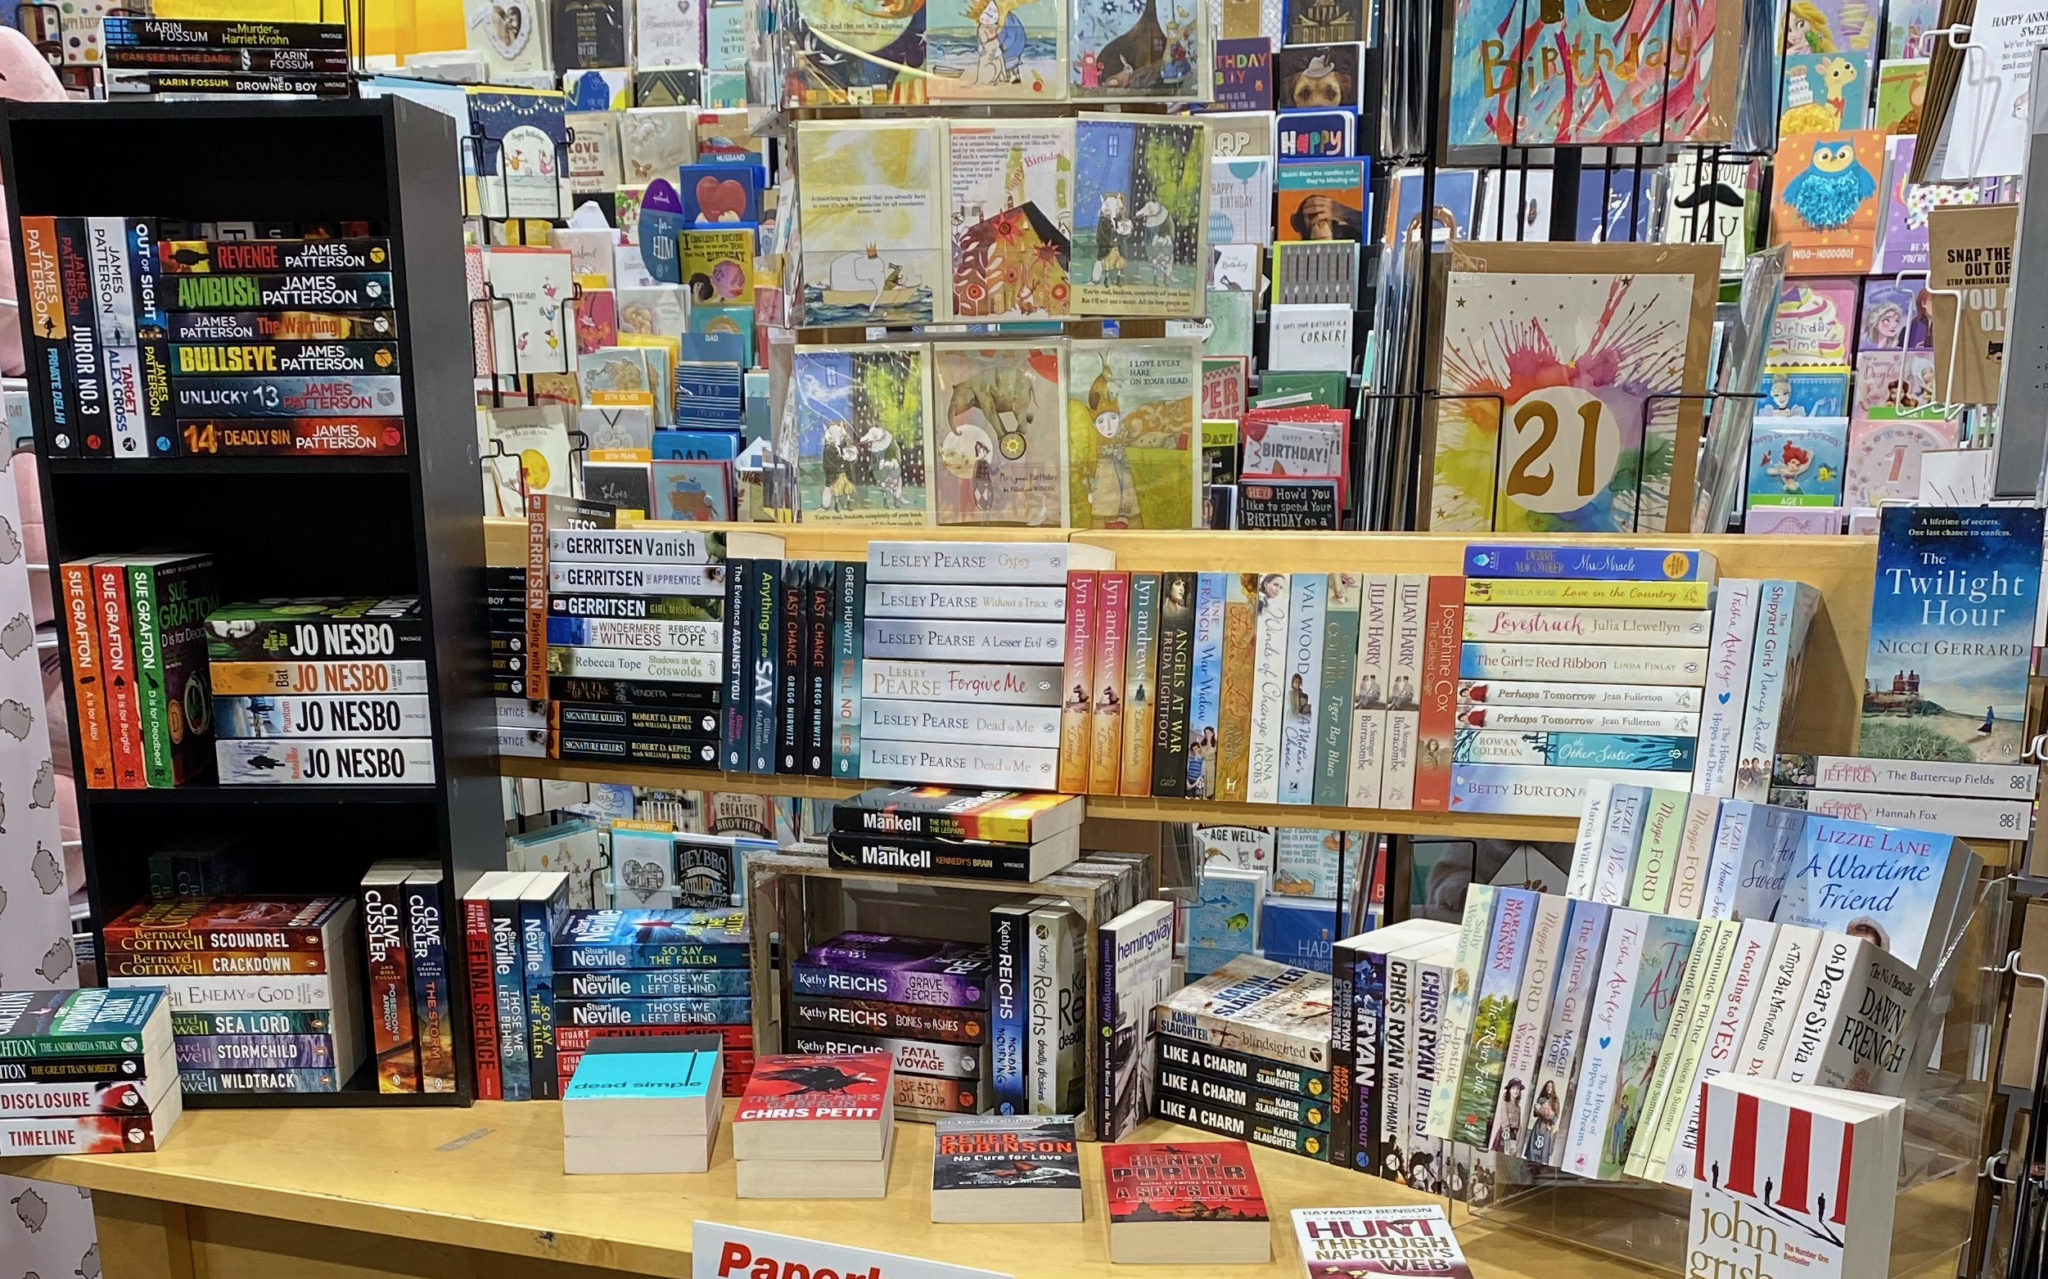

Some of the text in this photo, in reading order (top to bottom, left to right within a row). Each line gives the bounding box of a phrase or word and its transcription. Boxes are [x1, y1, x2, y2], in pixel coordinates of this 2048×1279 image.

[145, 22, 182, 34] KARIN
[160, 31, 208, 42] FOSSUM
[222, 33, 289, 45] Harriet Krohn
[236, 81, 317, 92] DROWNED BOY
[716, 154, 745, 162] HUSBAND
[1212, 183, 1233, 194] HAPPY
[1220, 196, 1253, 209] BIRTHDAY
[217, 246, 279, 269] REVENGE
[301, 244, 348, 256] JAMES
[1947, 246, 2011, 264] SNAP THE
[286, 255, 365, 267] PATTERSON
[136, 224, 156, 320] OUT OF SIGHT
[179, 277, 260, 307] AMBUSH
[194, 316, 237, 327] JAMES
[258, 317, 336, 335] The Warning
[1773, 320, 1833, 339] Birthday
[180, 326, 252, 337] PATTERSON
[1301, 330, 1346, 344] CORKER!
[298, 346, 345, 358] JAMES
[1786, 339, 1817, 350] Time
[179, 347, 276, 372] BULLSEYE
[281, 357, 363, 370] PATTERSON
[72, 326, 99, 414] JUROR NO.3
[180, 387, 279, 407] UNLUCKY 13
[225, 430, 290, 445] DEADLY SIN
[1262, 445, 1329, 463] BIRTHDAY!
[1506, 400, 1602, 497] 21
[1246, 500, 1264, 510] like
[1267, 502, 1277, 511] to
[1281, 501, 1308, 512] spend
[1780, 496, 1797, 506] AGE
[1321, 517, 1327, 525] a
[567, 538, 695, 557] GERRITSEN Vanish
[530, 523, 544, 610] GERRITSEN
[1920, 552, 1946, 565] The
[568, 569, 701, 586] GERRITSEN APPRENTICE
[1885, 568, 2024, 601] Twilight
[762, 572, 771, 630] Anything
[787, 589, 796, 617] LAST
[134, 571, 155, 670] SUE GRAFTON
[1920, 600, 2005, 627] Hour
[599, 623, 661, 634] WINDERMERE
[1488, 611, 1681, 634] Lovestruck Julia Llewellyn
[600, 633, 661, 646] WITNESS
[786, 620, 796, 667] CHANCE
[878, 630, 1042, 648] LESLEY PEARSE A Lesser Evil
[1877, 640, 2024, 656] NICCI GERRARD
[576, 657, 642, 671] Rebecca Tope
[1434, 604, 1459, 713] Josephine Cox
[293, 664, 388, 693] JO NESBO
[754, 661, 774, 706] SAY
[948, 670, 1028, 696] Forgive Me
[1169, 628, 1187, 754] ANGELS AT WAR
[283, 701, 291, 733] Phantom
[296, 701, 400, 732] JO NESBO
[565, 711, 624, 722] SIGNATURE KILLERS
[786, 708, 794, 746] HURWITZ
[1887, 770, 1995, 785] The Buttercup Fields
[720, 803, 757, 817] GREATEST
[716, 819, 760, 833] BROTHER
[863, 812, 921, 832] Mankell
[1210, 829, 1256, 843] AGE WELL
[1815, 825, 1931, 857] LIZZIE LANE
[1797, 853, 1931, 883] A Wartime
[1818, 886, 1896, 912] Friend
[135, 930, 192, 939] Bernard
[210, 933, 289, 948] SCOUNDREL
[1116, 922, 1173, 962] hemingway
[120, 936, 204, 951] Cornwell
[585, 947, 611, 955] Stuart
[573, 950, 626, 966] Neville
[646, 974, 710, 983] THOSE WE
[799, 973, 887, 992] Kathy REICHS
[908, 976, 943, 991] GRAVE
[641, 984, 716, 994] LEFT BEHIND
[904, 989, 950, 1004] SECRETS
[215, 1016, 290, 1033] SEA LORD
[901, 1046, 939, 1059] FATAL
[1240, 1030, 1306, 1060] blindsighted
[1355, 1006, 1376, 1087] RYAN
[897, 1058, 945, 1071] VOYAGE
[1162, 1044, 1247, 1078] LIKE A CHARM
[1256, 1073, 1300, 1092] SLAUGHTER
[1276, 1068, 1300, 1082] KARIN
[574, 1081, 702, 1090] dead simple
[1, 1091, 91, 1109] DISCLOSURE
[740, 1107, 878, 1120] CHRIS PETIT
[1358, 1086, 1369, 1147] BLACKOUT
[8, 1130, 76, 1146] TIMELINE
[940, 1132, 1018, 1145] PETER
[940, 1141, 1073, 1154] ROBINSON
[972, 1153, 1004, 1162] Cure
[1008, 1153, 1026, 1161] for
[1029, 1153, 1062, 1161] Love
[1129, 1153, 1221, 1166] HENRY
[1111, 1166, 1246, 1181] PORTER
[1306, 1219, 1435, 1238] HUNT
[1700, 1193, 1779, 1256] john
